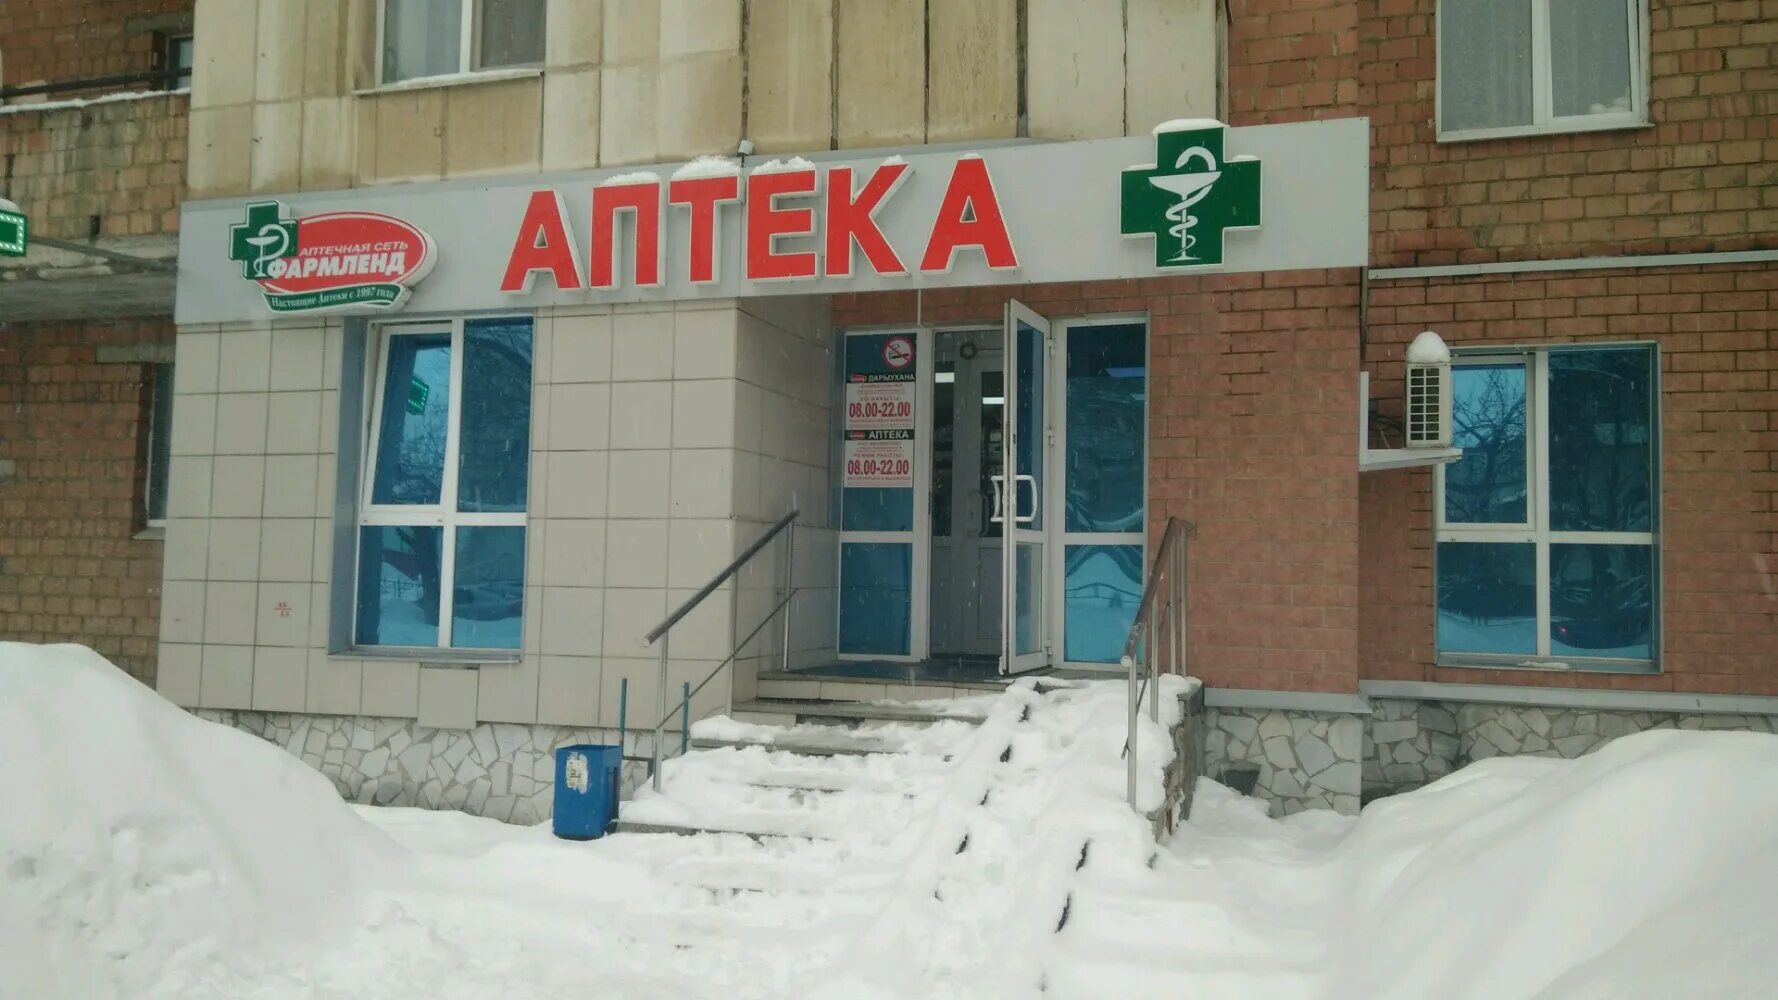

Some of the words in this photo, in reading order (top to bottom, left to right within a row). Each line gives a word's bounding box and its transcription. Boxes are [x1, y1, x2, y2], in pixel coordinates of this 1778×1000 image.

[500, 158, 1020, 292] АПТЕКА
[300, 244, 371, 257] АПТЕЧНАЯ
[373, 240, 409, 252] СЕТЬ
[266, 251, 406, 280] ФАРМЛЕНД
[271, 295, 317, 308] Настоящие
[319, 291, 348, 303] Аптеки
[356, 286, 376, 298] 1997
[377, 288, 395, 299] года
[868, 373, 915, 382] ДАРЫУХАНА
[849, 401, 911, 417] 08.00-22.00
[868, 430, 909, 439] АПТЕКА
[847, 459, 909, 475] 08.00-22.00
